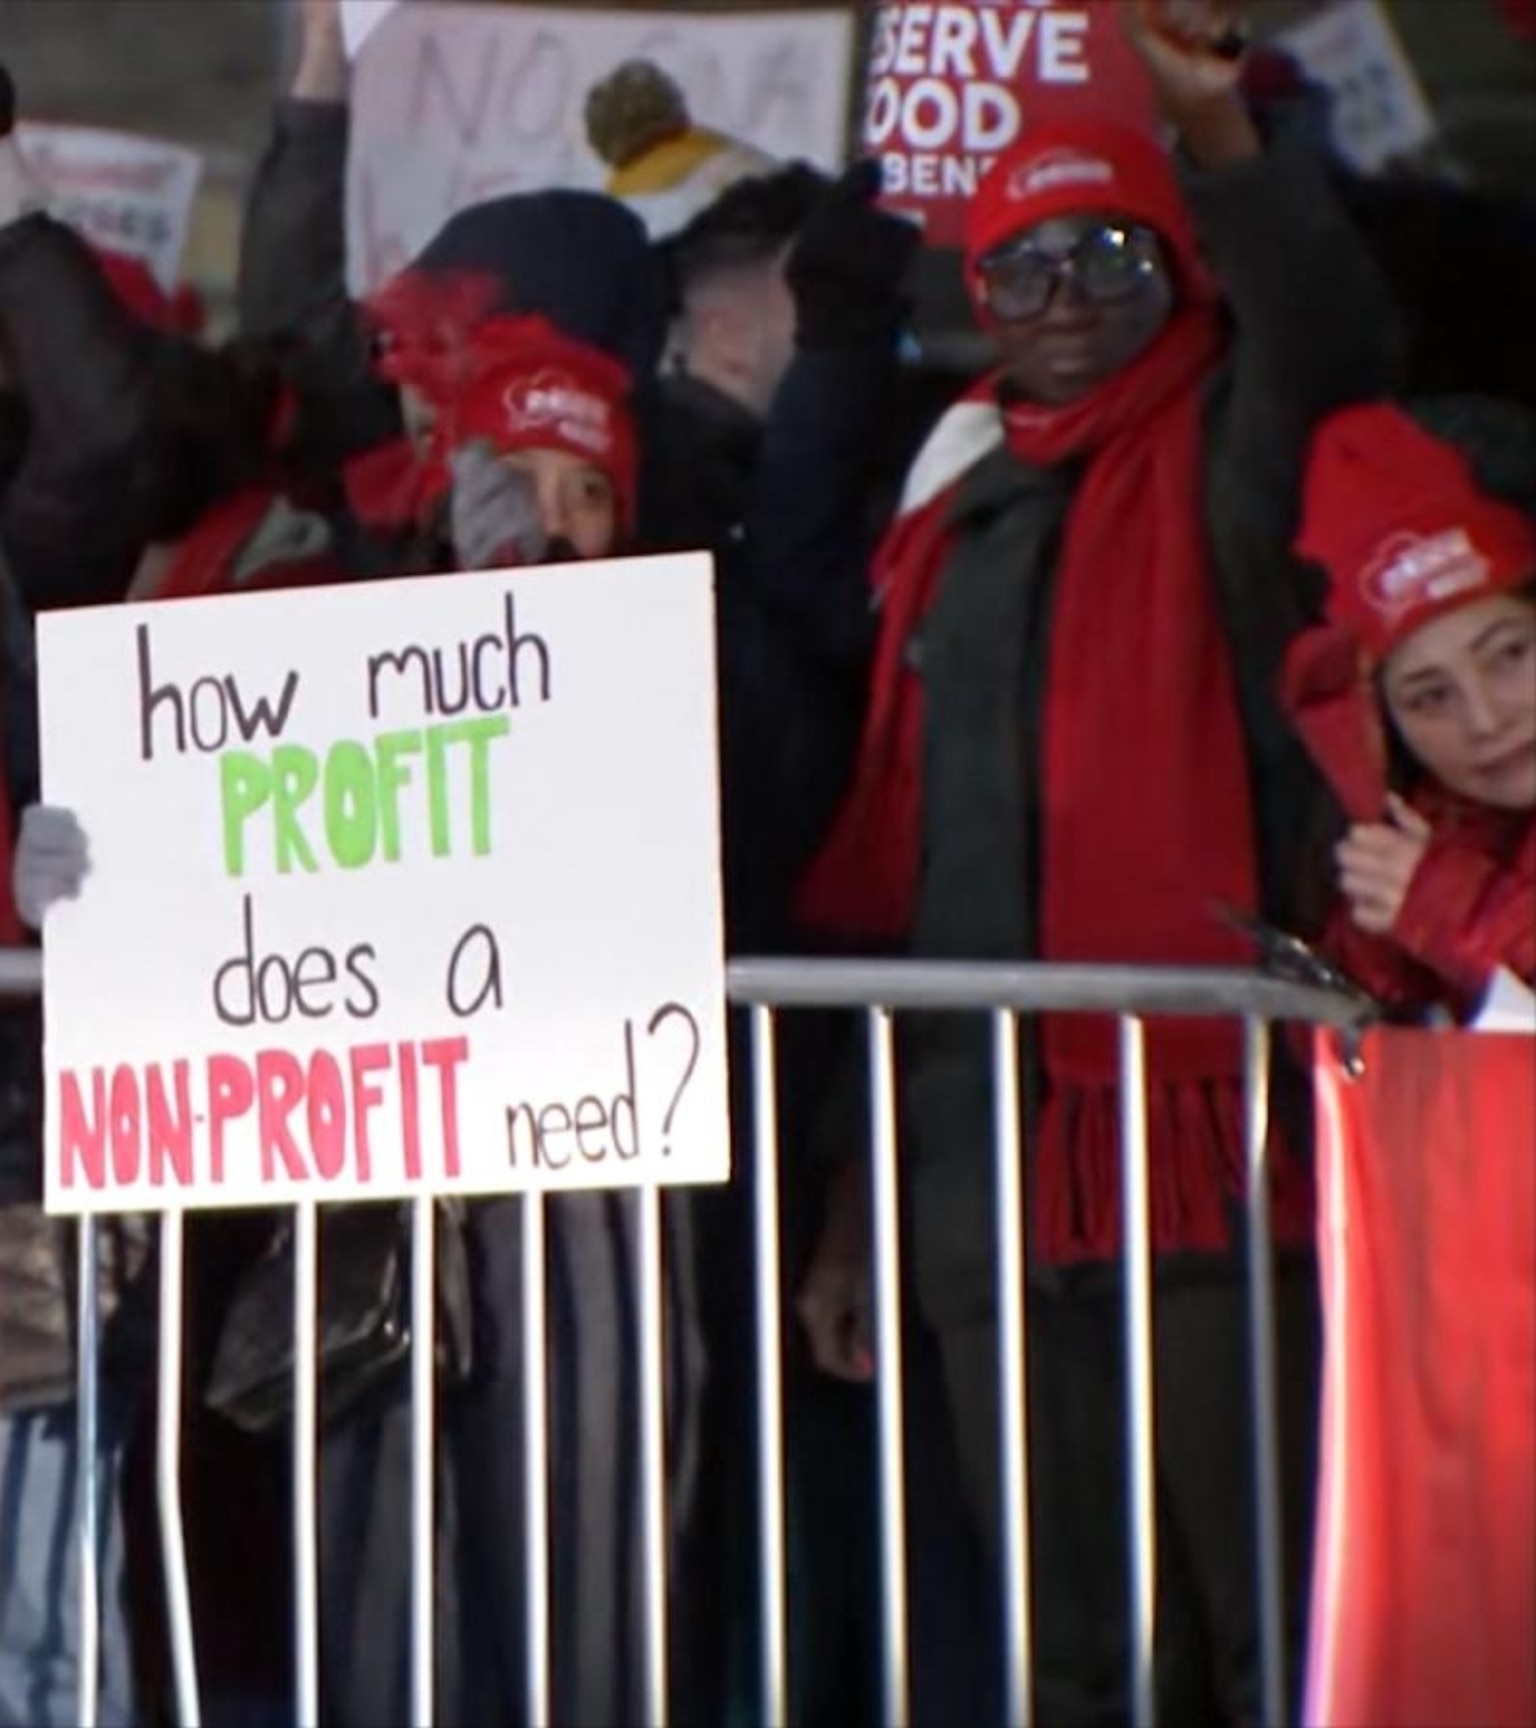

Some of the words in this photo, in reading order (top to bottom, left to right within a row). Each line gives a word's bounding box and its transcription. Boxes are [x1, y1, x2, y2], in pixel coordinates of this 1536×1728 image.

[864, 76, 1022, 150] OOD
[869, 4, 1090, 84] SERVE
[135, 622, 299, 761] how
[366, 590, 551, 718] much
[217, 713, 511, 878] PROFIT
[212, 893, 380, 1027] does
[445, 922, 504, 1018] a
[505, 1001, 701, 1171] need?
